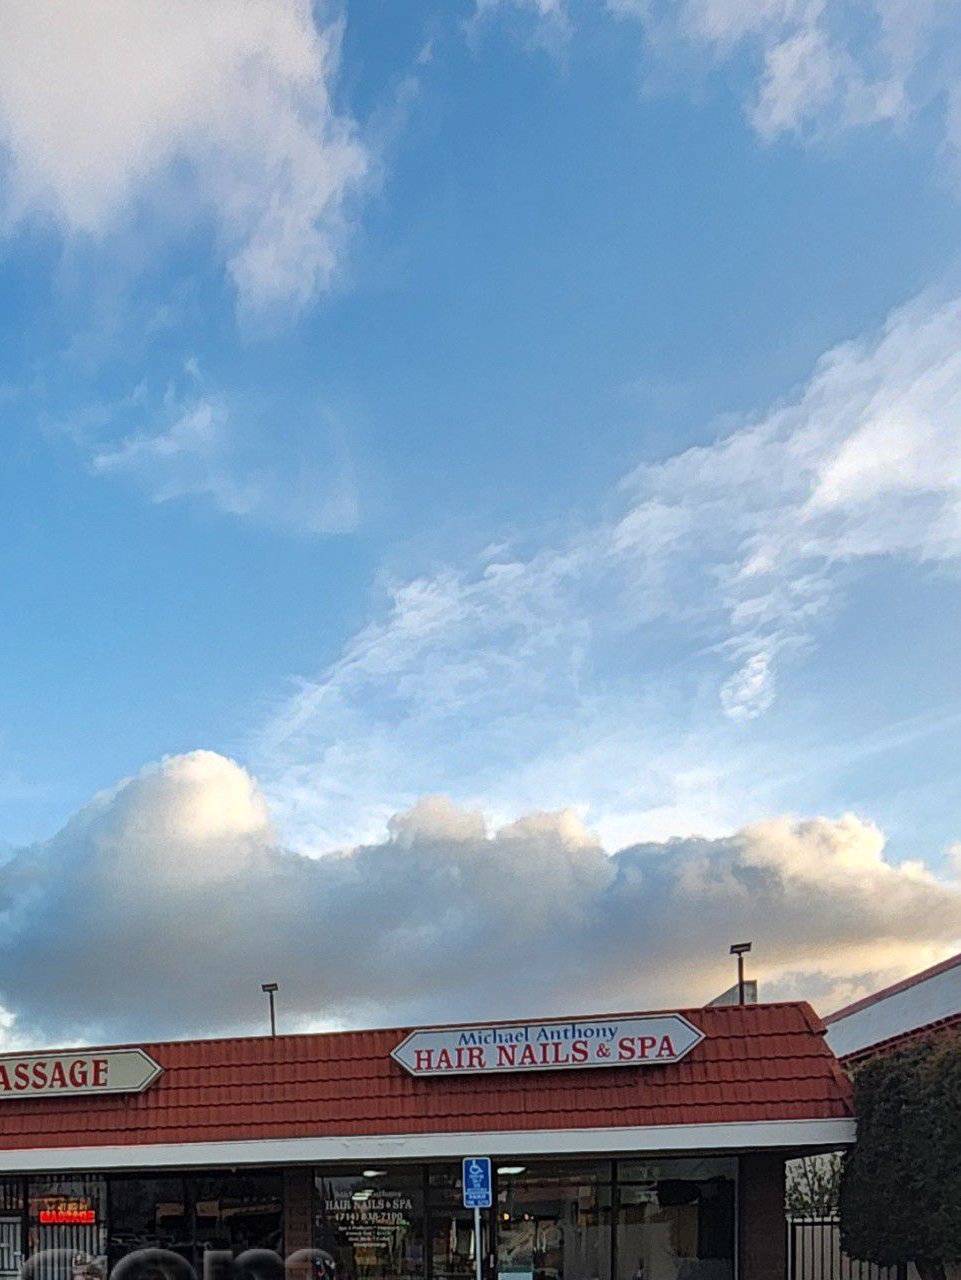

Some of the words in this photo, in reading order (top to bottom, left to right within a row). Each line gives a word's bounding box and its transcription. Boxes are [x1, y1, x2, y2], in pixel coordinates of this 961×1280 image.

[458, 1027, 529, 1046] Michael
[537, 1024, 618, 1042] Anthony
[414, 1047, 487, 1071] HAIR
[496, 1041, 588, 1067] NAILS
[596, 1044, 611, 1058] &
[618, 1036, 677, 1060] SPA
[325, 1200, 351, 1211] HAIR
[392, 1199, 412, 1210] SPA
